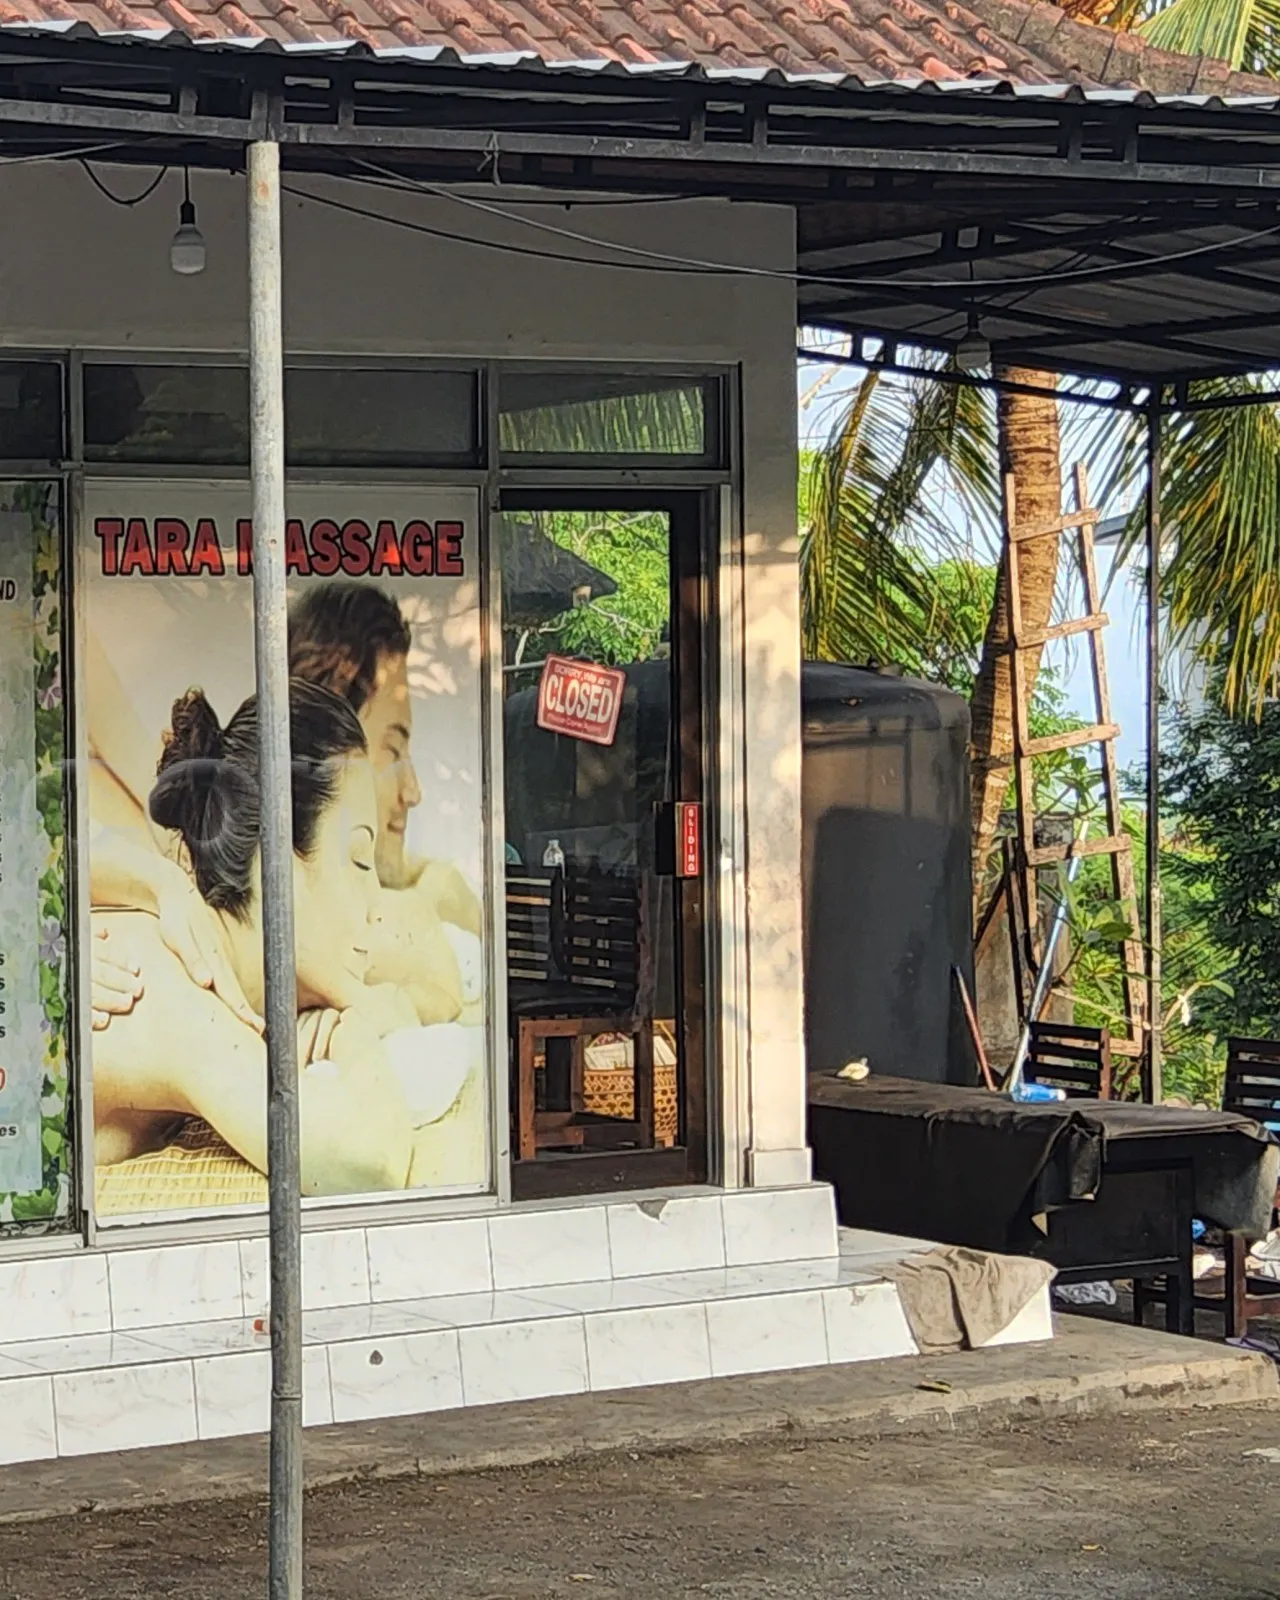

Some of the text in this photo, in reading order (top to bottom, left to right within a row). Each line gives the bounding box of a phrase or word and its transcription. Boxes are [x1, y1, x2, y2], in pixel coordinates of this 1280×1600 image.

[95, 518, 224, 576] TARA
[546, 674, 613, 723] CLOSED
[687, 808, 696, 872] SLIDING
